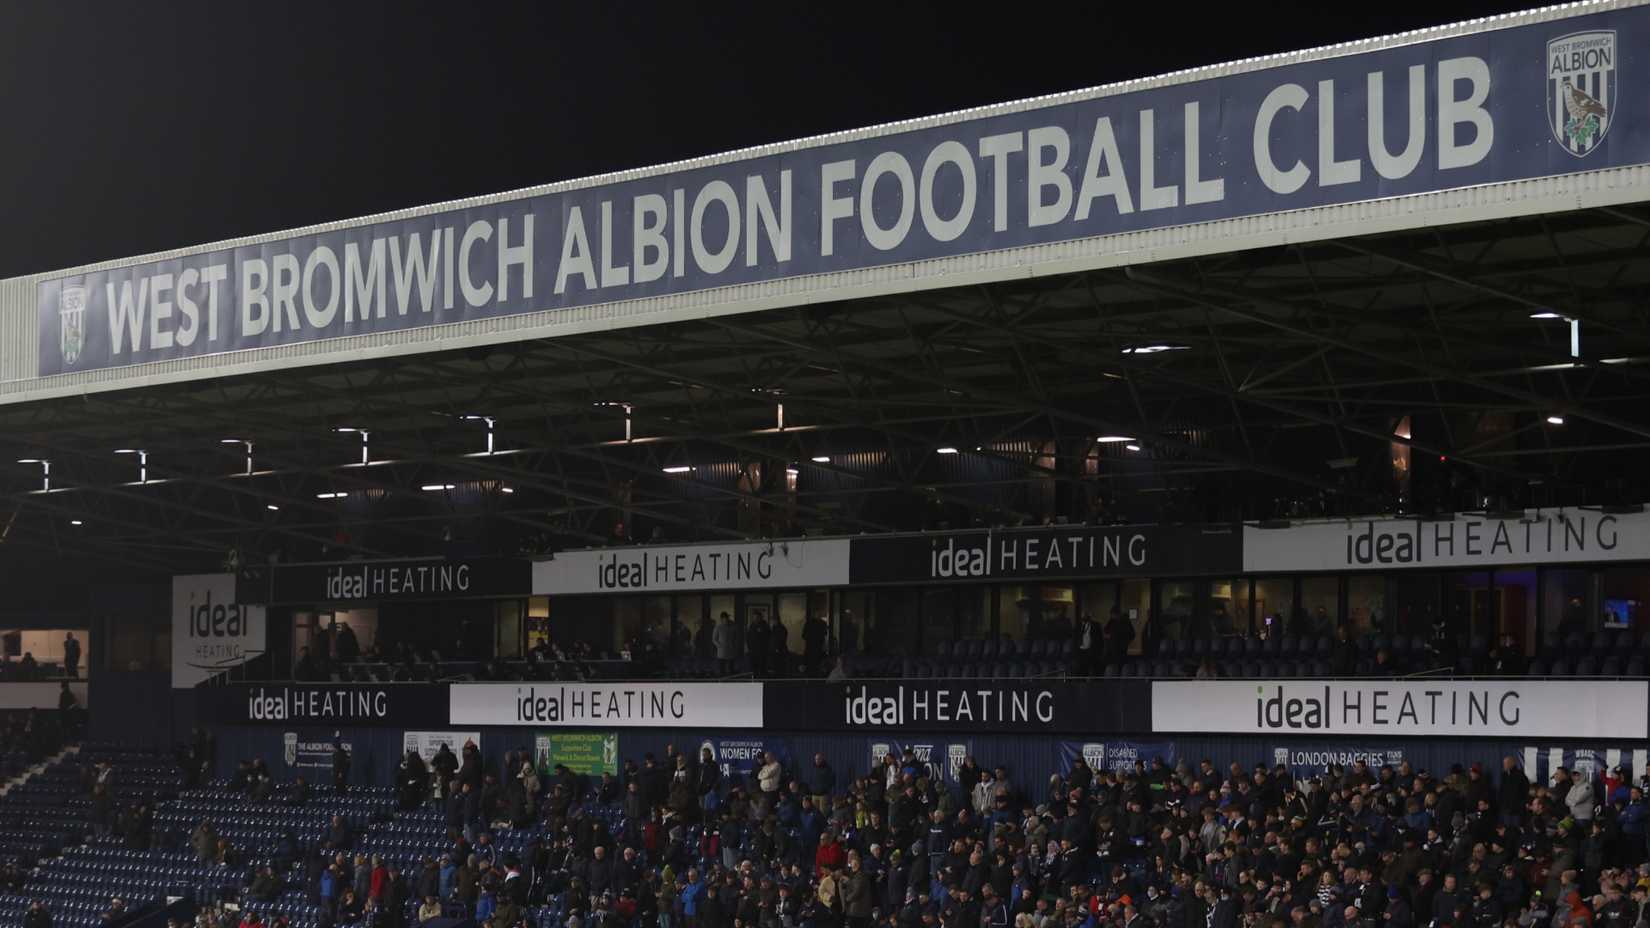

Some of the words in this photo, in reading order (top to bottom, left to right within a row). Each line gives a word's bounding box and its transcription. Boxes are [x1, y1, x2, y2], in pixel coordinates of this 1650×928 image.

[1551, 48, 1611, 74] ALBION
[106, 264, 228, 355] WEST
[241, 216, 535, 338] BROMWICH
[553, 168, 793, 295] ALBION
[820, 101, 1226, 257] FOOTBALL
[1252, 56, 1495, 195] CLUB
[931, 533, 992, 577] ideal
[1000, 534, 1146, 571] HEATING
[1347, 520, 1422, 564] ideal
[1434, 515, 1618, 557] HEATING
[327, 565, 368, 599] ideal
[373, 564, 469, 594] HEATING
[599, 552, 648, 588] ideal
[655, 552, 772, 583] HEATING
[189, 589, 248, 638] ideal
[196, 644, 241, 659] HEATING
[249, 687, 289, 720] ideal
[294, 691, 387, 717] HEATING
[517, 687, 565, 722] ideal
[571, 690, 684, 719] HEATING
[845, 685, 904, 725] ideal
[913, 690, 1053, 723] HEATING
[1257, 685, 1331, 729] ideal
[1343, 690, 1520, 726] HEATING
[719, 747, 750, 760] WOMEN
[1291, 751, 1337, 766] LONDON
[1339, 752, 1384, 767] BAGGIES
